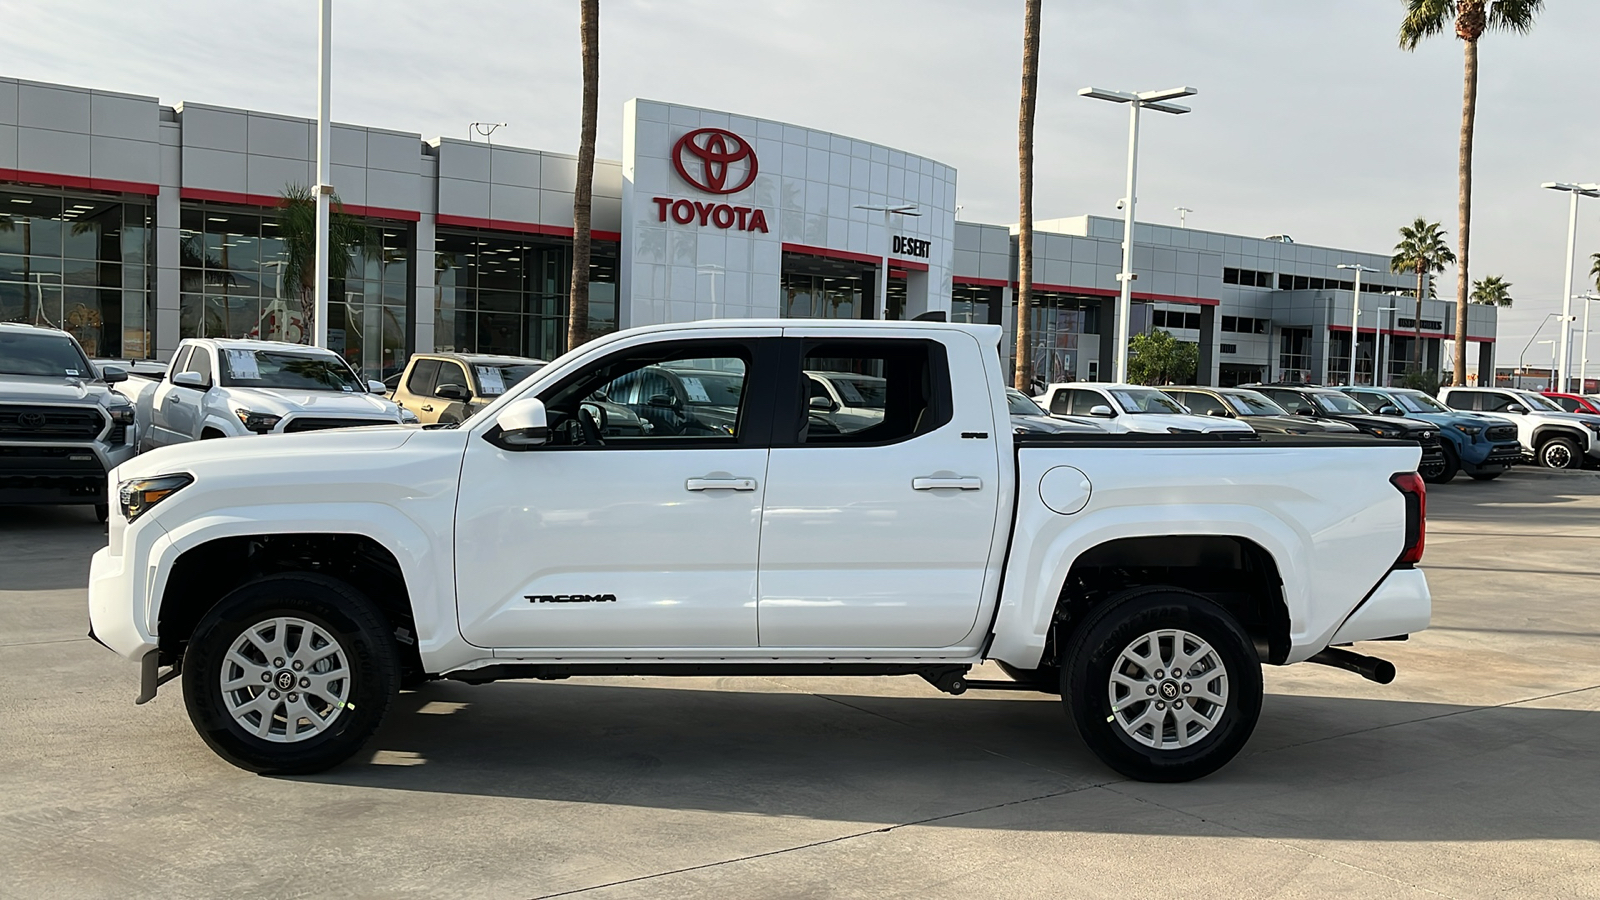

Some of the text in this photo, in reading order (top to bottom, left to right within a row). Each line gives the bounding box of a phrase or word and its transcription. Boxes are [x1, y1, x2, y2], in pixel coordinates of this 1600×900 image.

[652, 197, 769, 233] TOYOTA
[892, 235, 932, 258] DESERT
[523, 594, 617, 603] TACOMA
